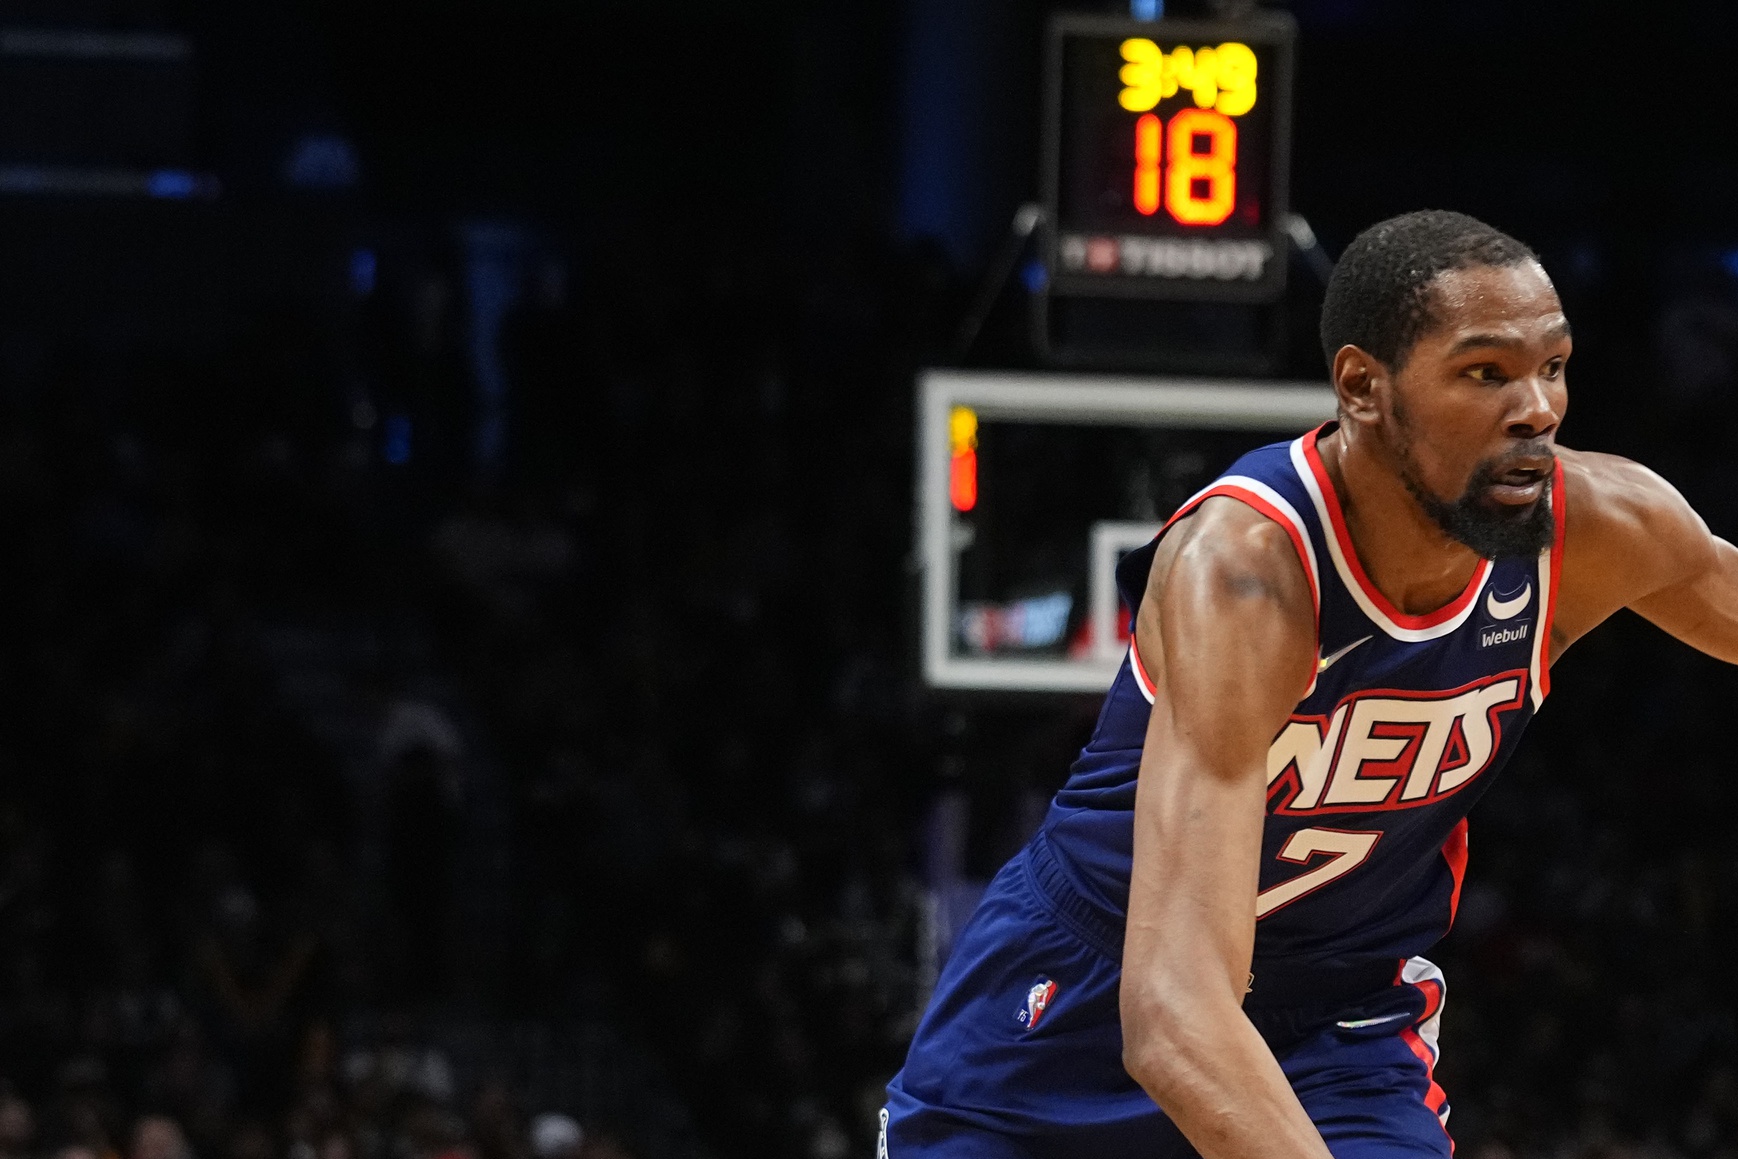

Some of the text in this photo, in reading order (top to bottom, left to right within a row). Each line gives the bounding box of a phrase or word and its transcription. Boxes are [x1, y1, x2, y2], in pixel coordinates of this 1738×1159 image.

[1119, 38, 1258, 116] 3:49
[1133, 108, 1237, 226] 18
[1482, 624, 1528, 648] Webull
[1266, 674, 1524, 812] NETS
